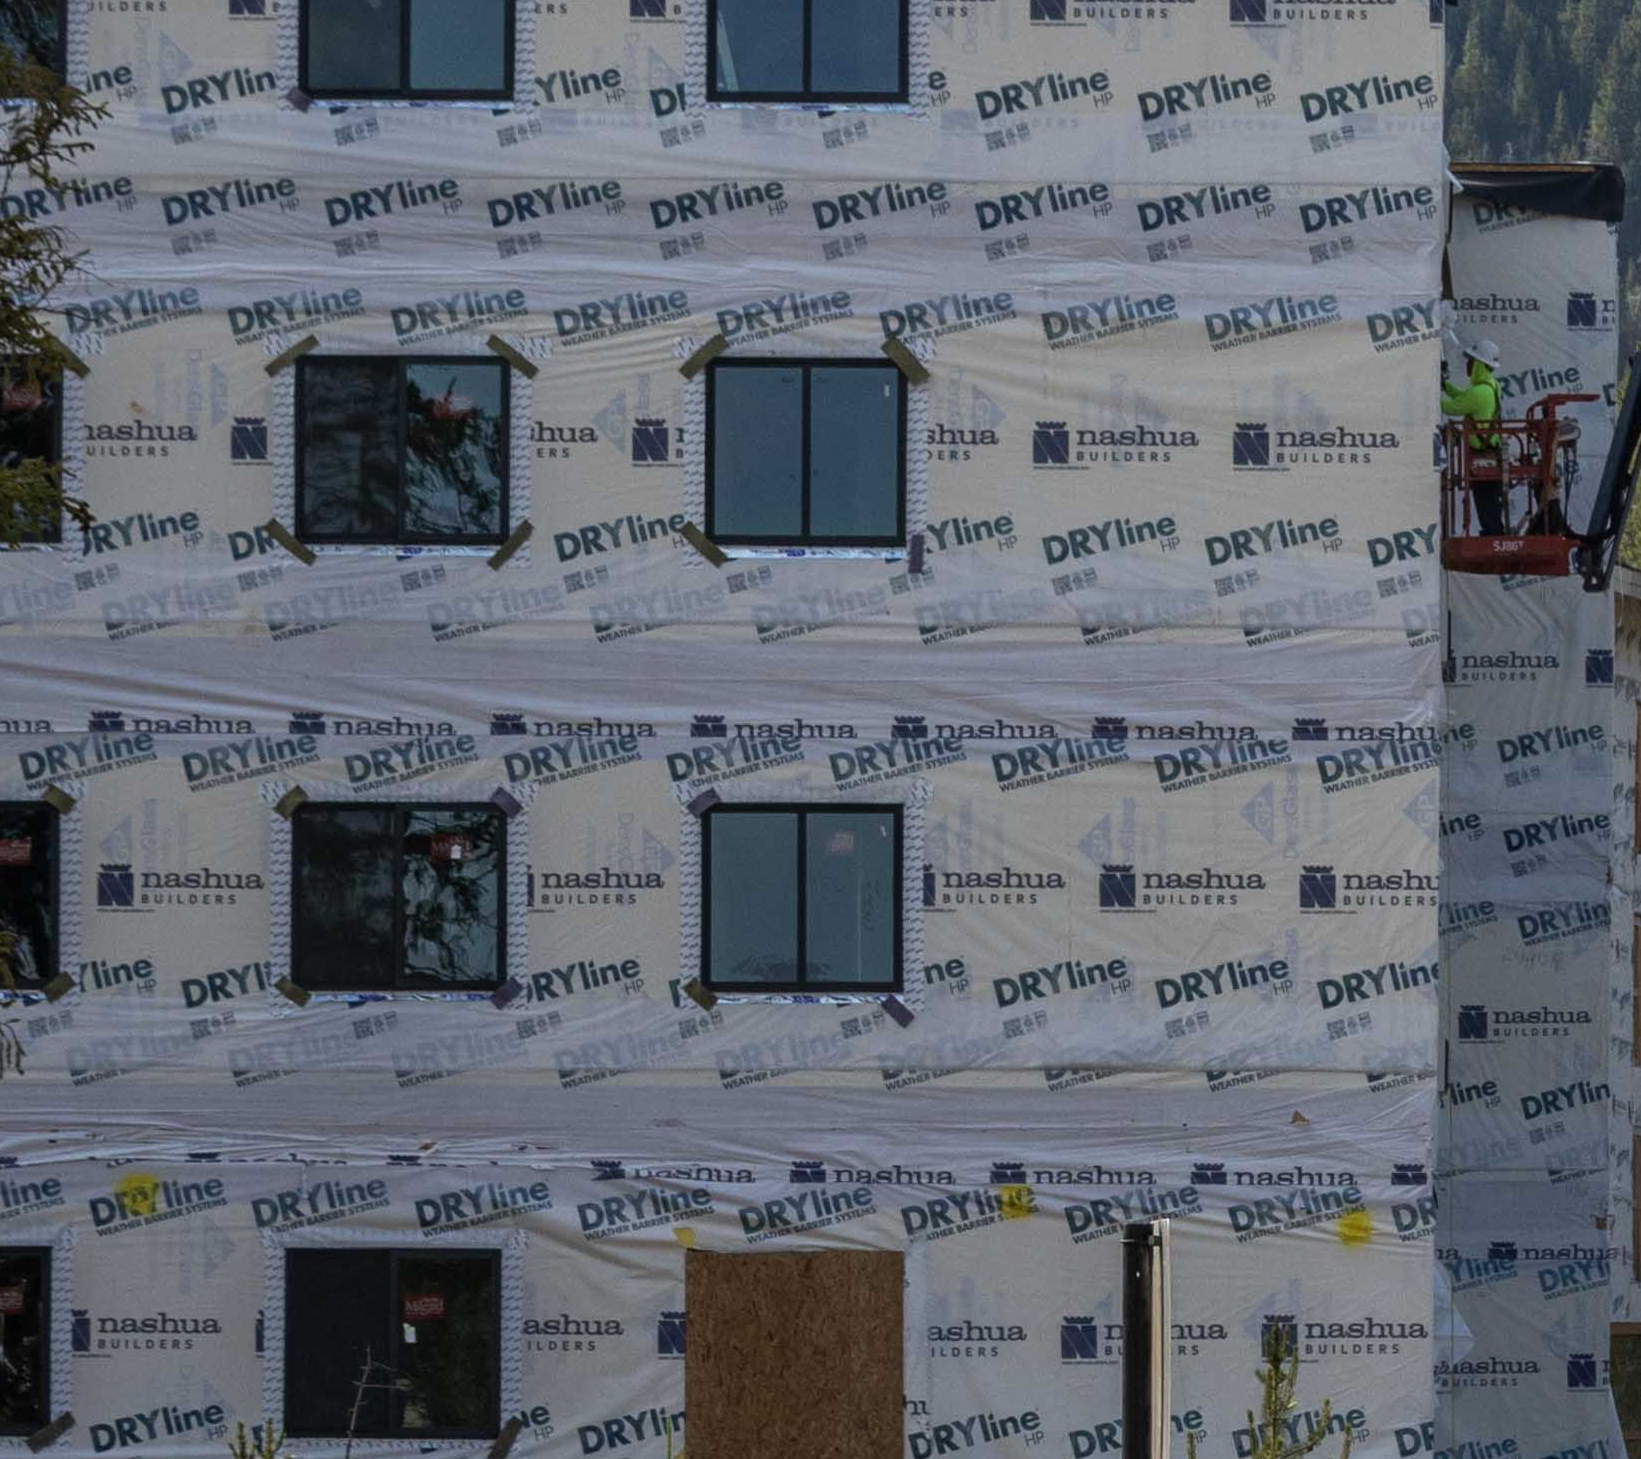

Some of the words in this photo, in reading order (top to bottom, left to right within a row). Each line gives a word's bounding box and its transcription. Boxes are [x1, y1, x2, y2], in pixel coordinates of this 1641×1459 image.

[1073, 7, 1168, 19] BUILDERS
[1273, 8, 1368, 20] BUILDERS
[975, 71, 1109, 120] DRYline
[1137, 72, 1271, 121] DRYline
[1300, 74, 1434, 123] DRYline
[162, 177, 296, 226] DRYline
[324, 178, 458, 227] DRYline
[487, 179, 621, 228] DRYline
[650, 180, 784, 229] DRYline
[812, 181, 946, 230] DRYline
[975, 182, 1109, 231] DRYline
[1137, 183, 1271, 232] DRYline
[1299, 185, 1433, 234] DRYline
[228, 287, 362, 336] DRYline
[1041, 292, 1175, 341] DRYline
[1204, 293, 1338, 342] DRYline
[1076, 424, 1199, 447] nashua
[1276, 425, 1399, 448] nashua
[1076, 450, 1171, 462] BUILDERS
[1276, 452, 1371, 464] BUILDERS
[1042, 516, 1176, 565] DRYline
[1204, 517, 1338, 566] DRYline
[1462, 651, 1559, 669] nashua
[1462, 672, 1537, 681] BUILDERS
[132, 713, 255, 736] nashua
[333, 714, 456, 737] nashua
[533, 715, 656, 738] nashua
[734, 717, 857, 740] nashua
[1135, 719, 1258, 742] nashua
[1498, 724, 1604, 763] DRYline
[19, 734, 153, 781] DRYline
[829, 735, 963, 782] DRYline
[992, 736, 1126, 783] DRYline
[1154, 737, 1288, 784] DRYline
[1504, 813, 1610, 853] DRYline
[141, 866, 264, 889] nashua
[541, 866, 664, 889] nashua
[942, 866, 1065, 889] nashua
[1143, 867, 1266, 890] nashua
[141, 893, 236, 905] BUILDERS
[541, 893, 636, 905] BUILDERS
[942, 893, 1037, 905] BUILDERS
[1143, 894, 1238, 906] BUILDERS
[993, 959, 1127, 1008] DRYline
[1155, 959, 1289, 1008] DRYline
[1493, 1006, 1592, 1024] nashua
[1494, 1027, 1570, 1037] BUILDERS
[1234, 1165, 1357, 1188] nashua
[252, 1178, 386, 1227] DRYline
[98, 1311, 221, 1334] nashua
[1305, 1316, 1428, 1339] nashua
[98, 1338, 193, 1350] BUILDERS
[1305, 1343, 1400, 1355] BUILDERS
[89, 1404, 223, 1453] DRYline
[906, 1411, 1040, 1459] DRYline
